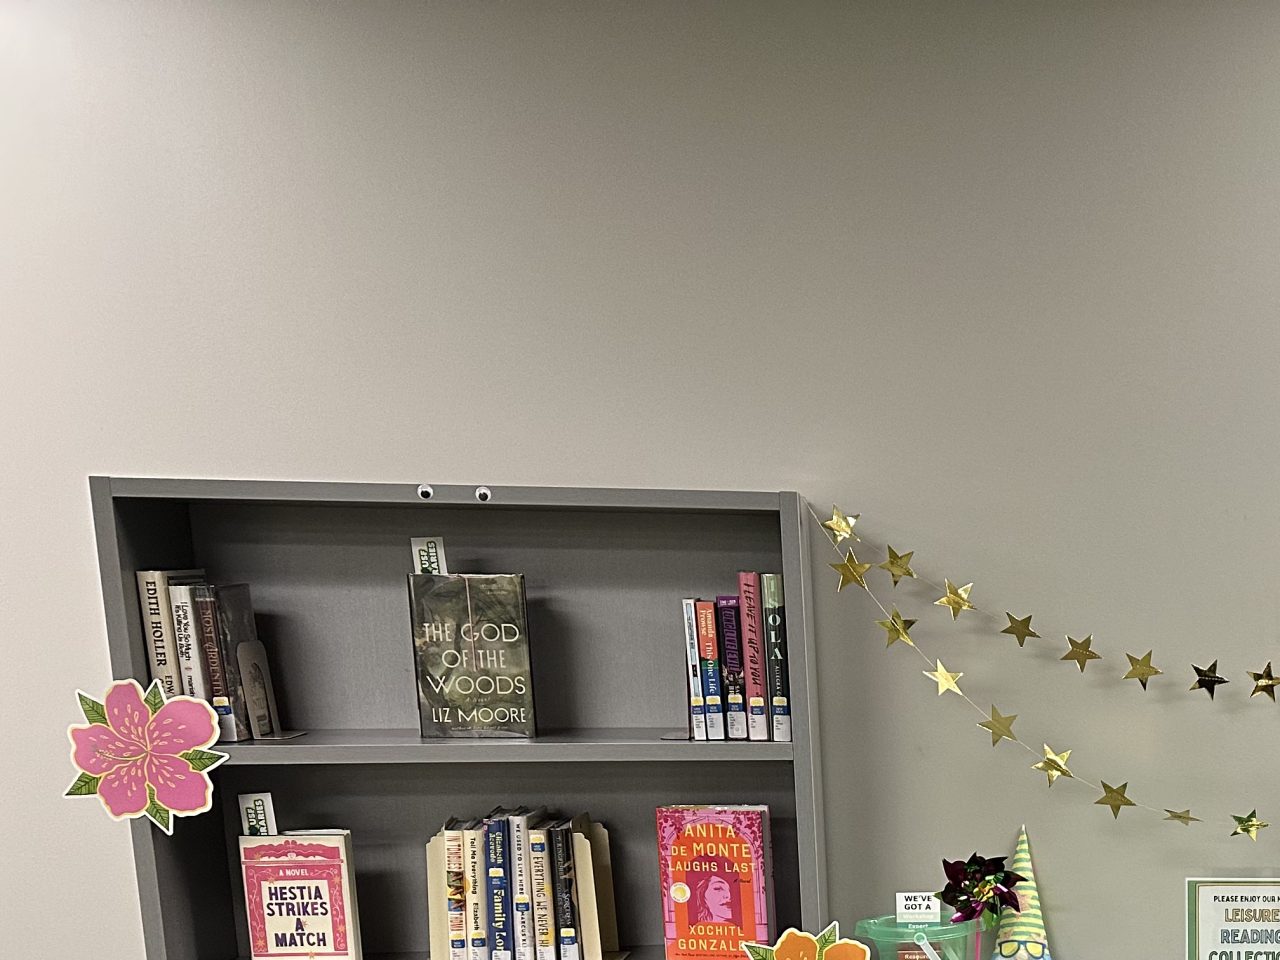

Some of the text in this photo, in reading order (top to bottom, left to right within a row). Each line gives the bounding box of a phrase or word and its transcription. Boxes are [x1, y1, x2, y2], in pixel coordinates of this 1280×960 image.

[420, 550, 429, 568] USF
[146, 581, 167, 666] EDITH HOLLER
[705, 609, 713, 638] Amanda
[749, 624, 756, 637] IT
[423, 623, 519, 642] THE GOD
[749, 638, 759, 653] UP
[442, 650, 506, 668] OF THE
[752, 667, 761, 686] YOU
[426, 676, 526, 694] WOODS
[432, 708, 527, 723] LIZ MOORE
[684, 824, 736, 838] ANITA
[671, 843, 751, 857] DE MONTE
[669, 861, 757, 873] LAUGHS LAST
[268, 886, 323, 901] HESTIA
[532, 856, 549, 940] EVERYTHING WE NEVER
[267, 902, 329, 916] STRIKES
[493, 889, 505, 929] Family
[1225, 908, 1280, 922] LEISURE
[295, 918, 305, 932] A
[689, 925, 744, 936] XOCHITL
[275, 933, 327, 947] MATCH
